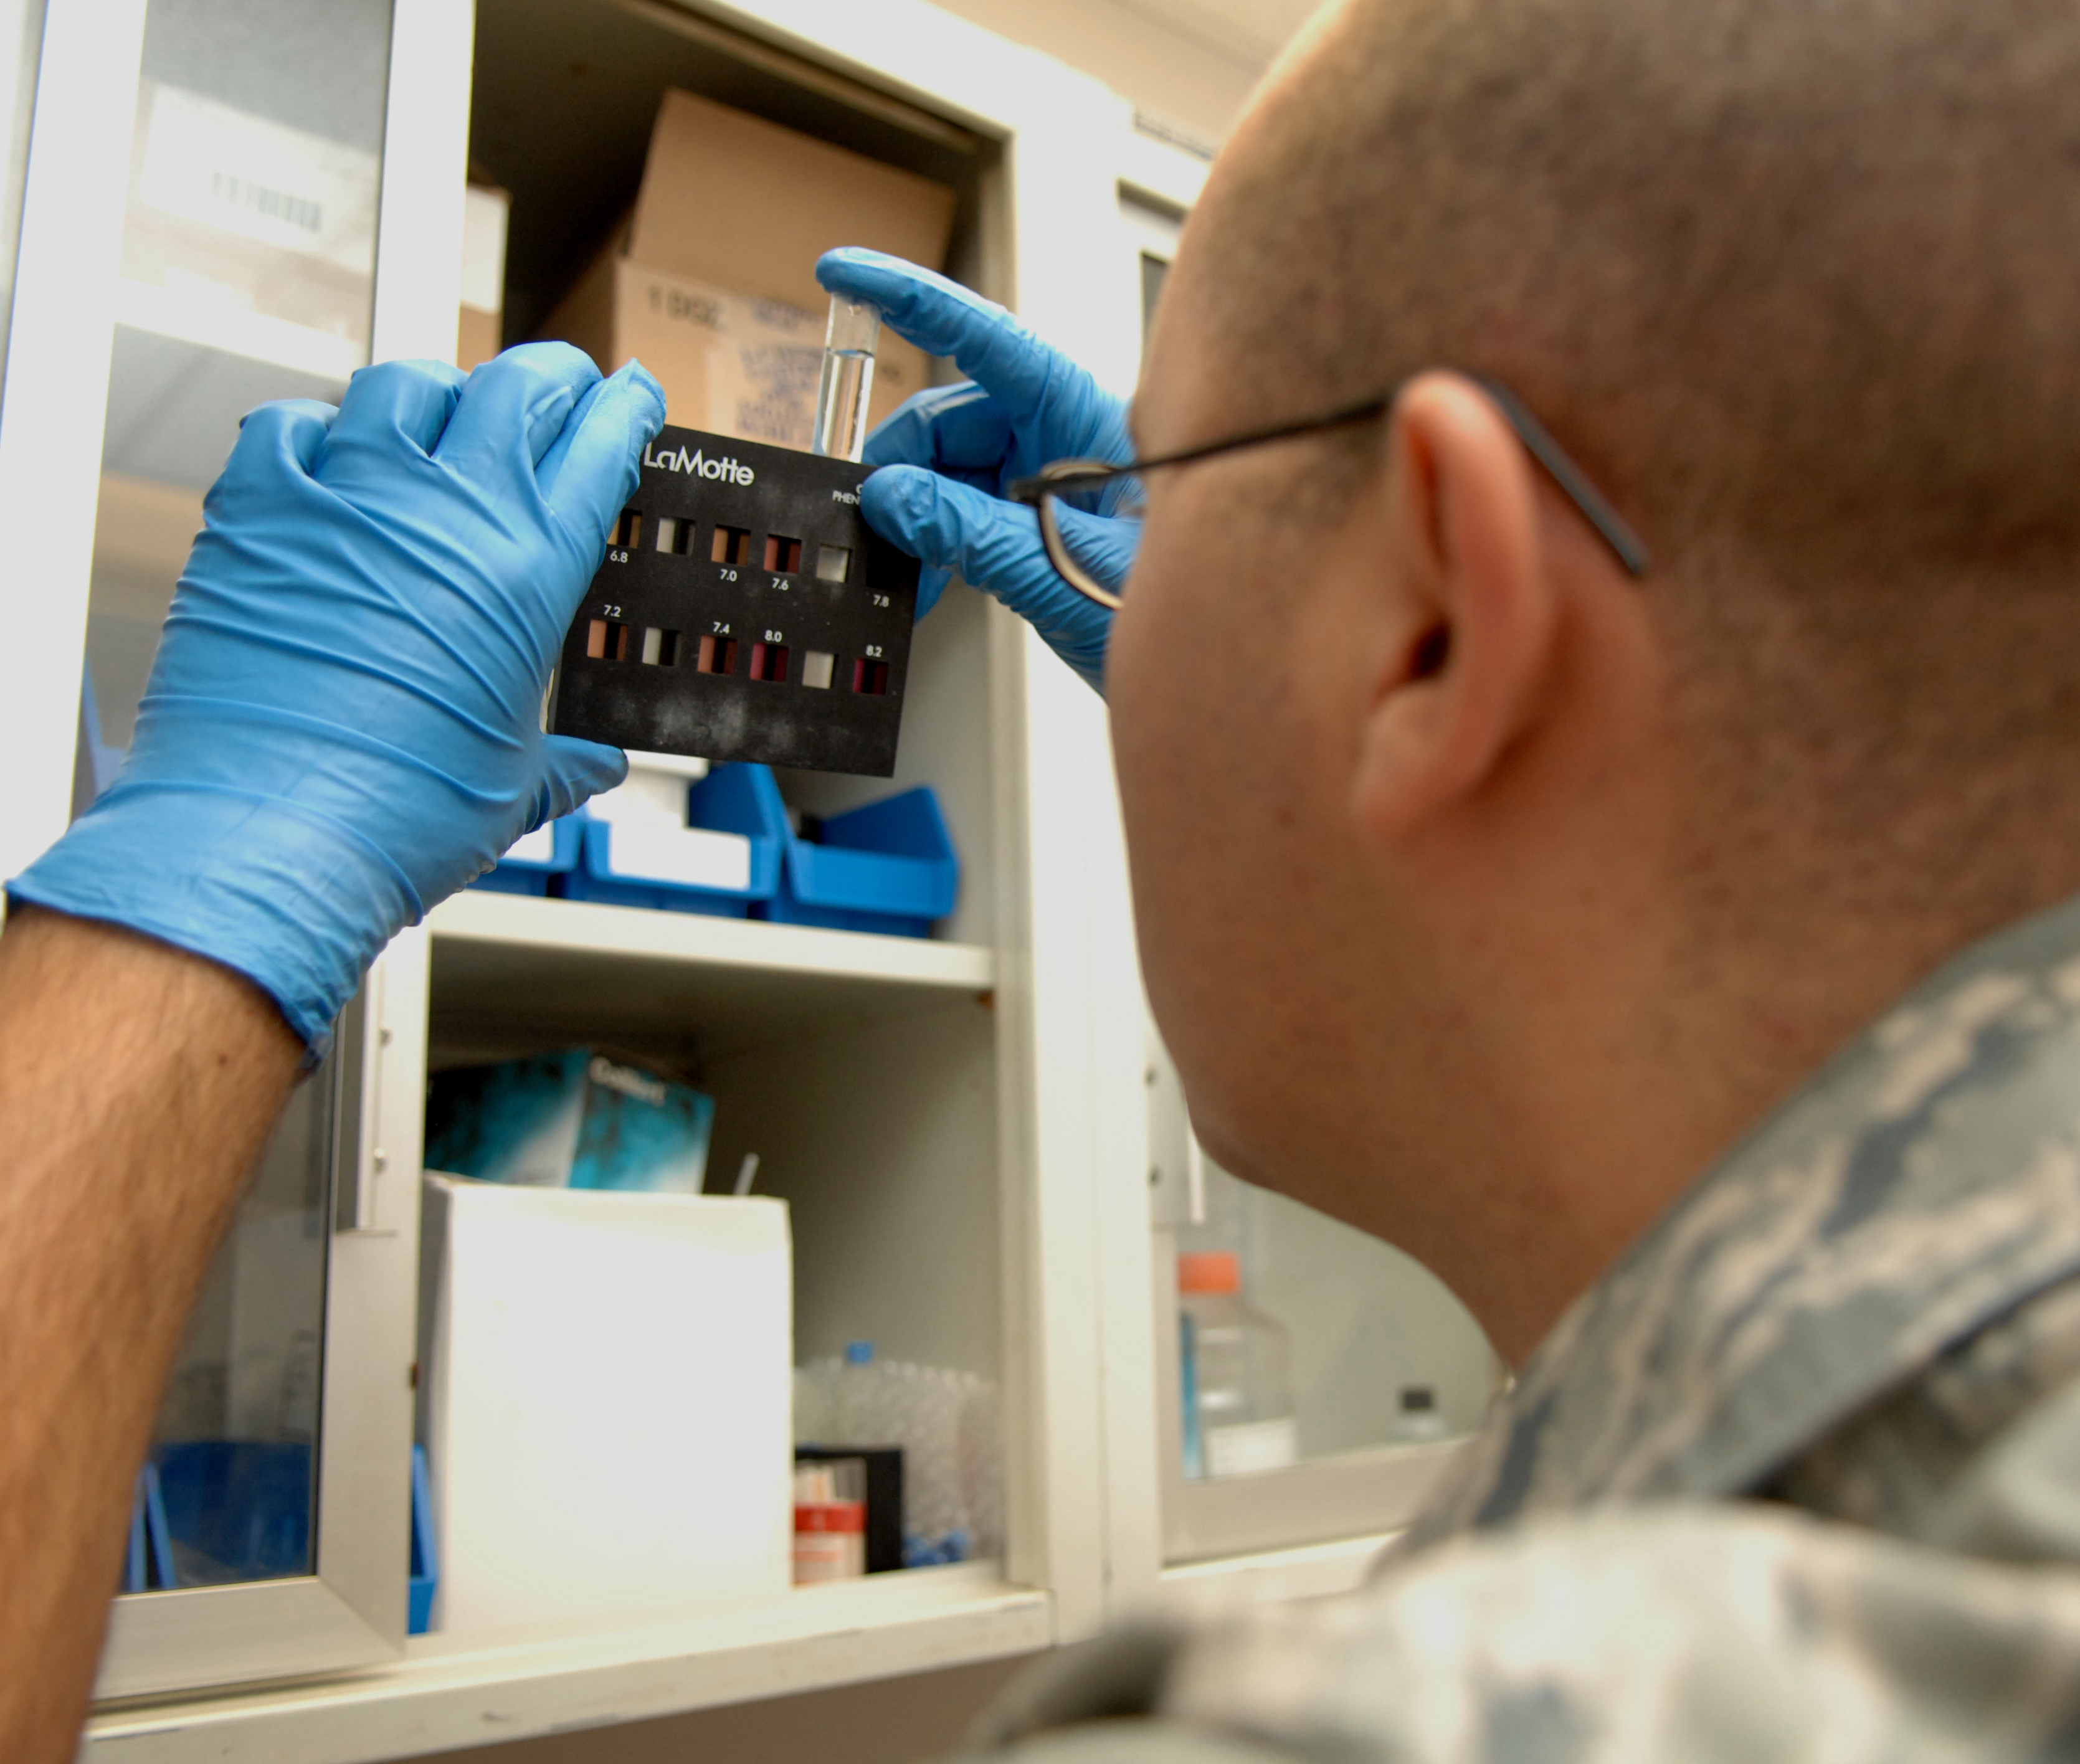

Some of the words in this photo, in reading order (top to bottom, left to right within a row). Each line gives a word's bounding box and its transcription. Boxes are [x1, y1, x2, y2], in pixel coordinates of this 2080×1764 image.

[643, 442, 755, 486] LaMotte
[832, 490, 861, 506] PHEN
[609, 550, 629, 564] 6.8
[719, 568, 738, 582] 7.0
[772, 577, 789, 591] 7.6
[873, 594, 890, 608] 7.8
[604, 604, 622, 618] 7.2
[713, 620, 730, 635] 7.4
[764, 629, 782, 643] 8.0
[865, 644, 882, 658] 8.2
